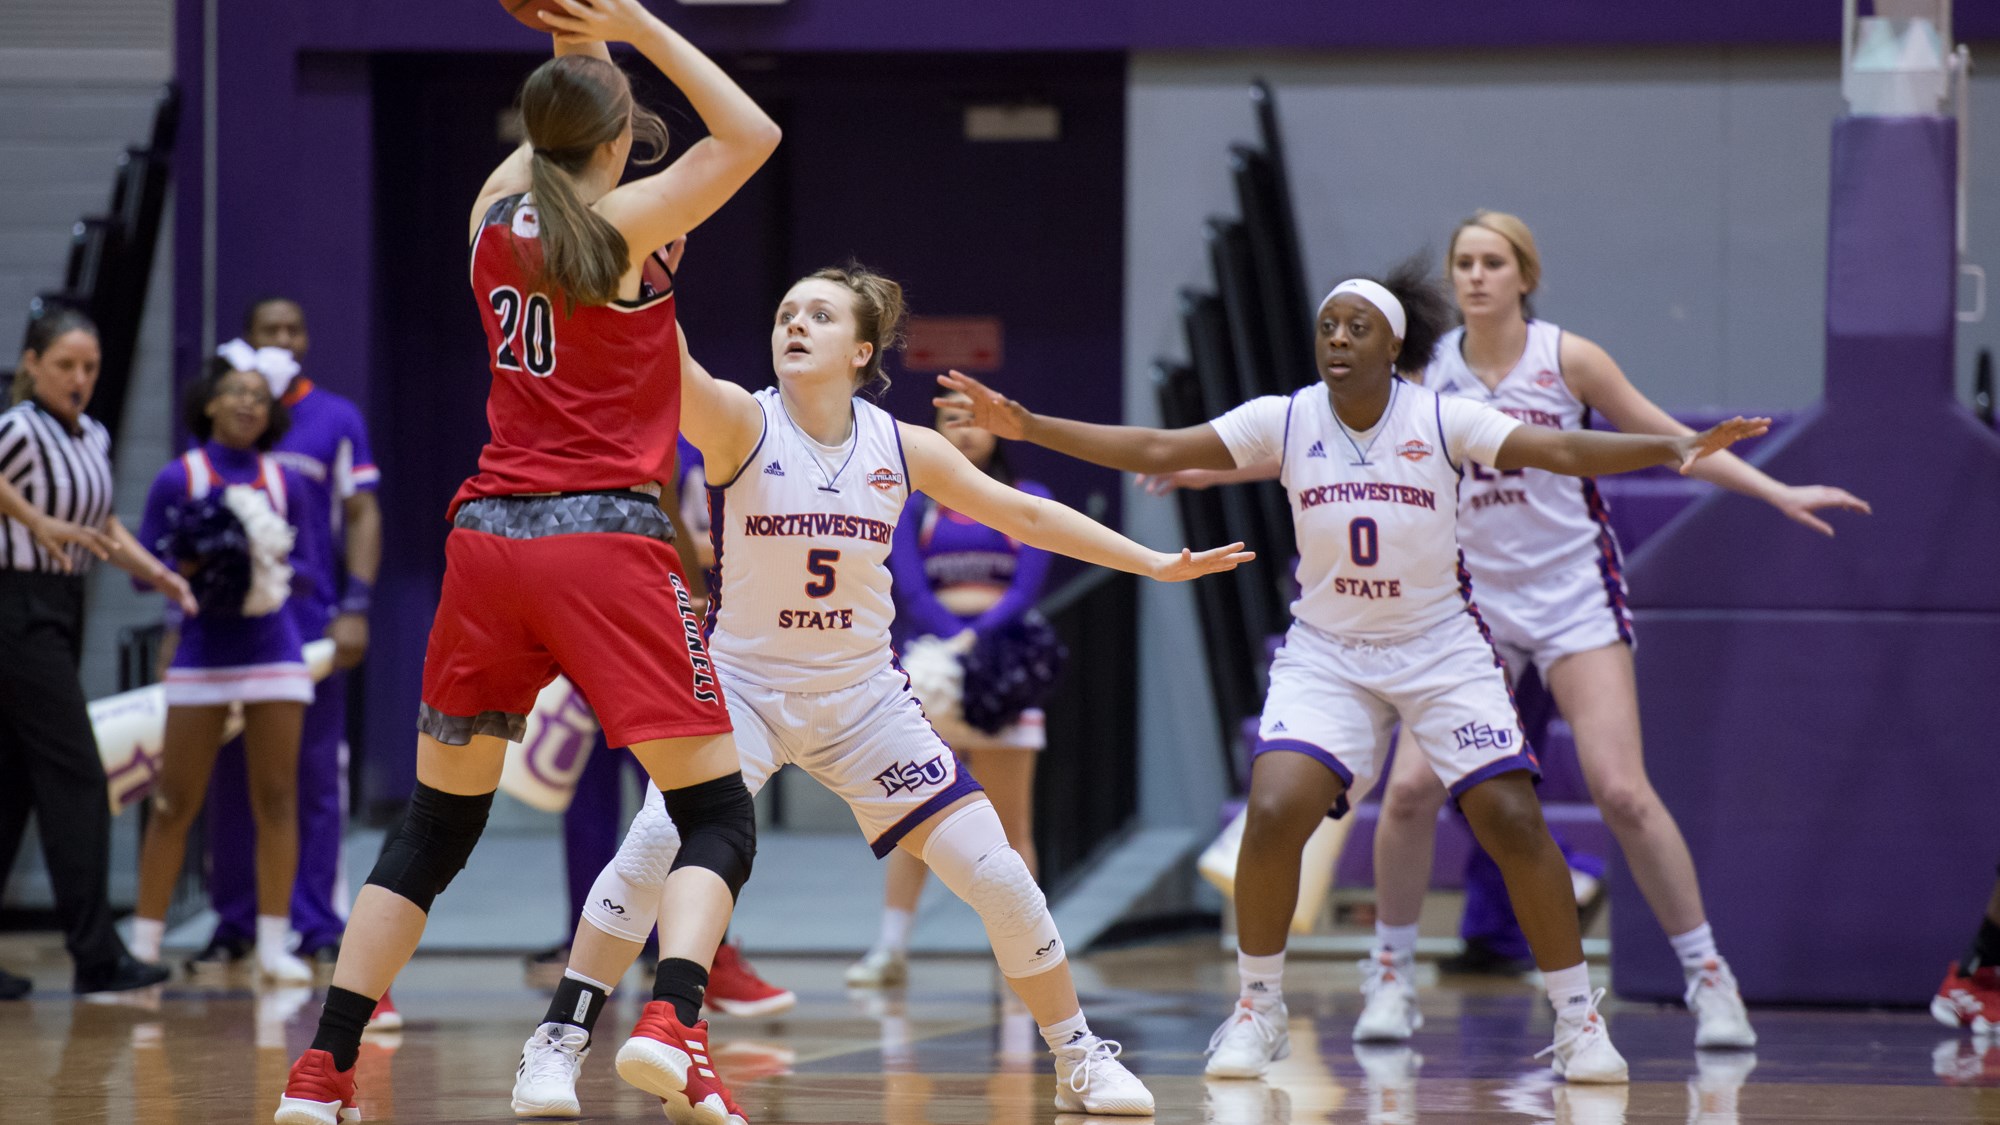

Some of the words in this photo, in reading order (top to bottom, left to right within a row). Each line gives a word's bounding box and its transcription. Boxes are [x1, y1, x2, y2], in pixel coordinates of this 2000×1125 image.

[489, 285, 556, 378] 20
[1300, 482, 1436, 511] NORTHWESTERN
[1349, 516, 1380, 568] 0
[804, 548, 842, 599] 5
[1334, 577, 1402, 600] STATE
[668, 571, 719, 706] COLONELS
[778, 608, 854, 631] STATE
[1452, 720, 1514, 751] NSU
[873, 754, 948, 798] NSU
